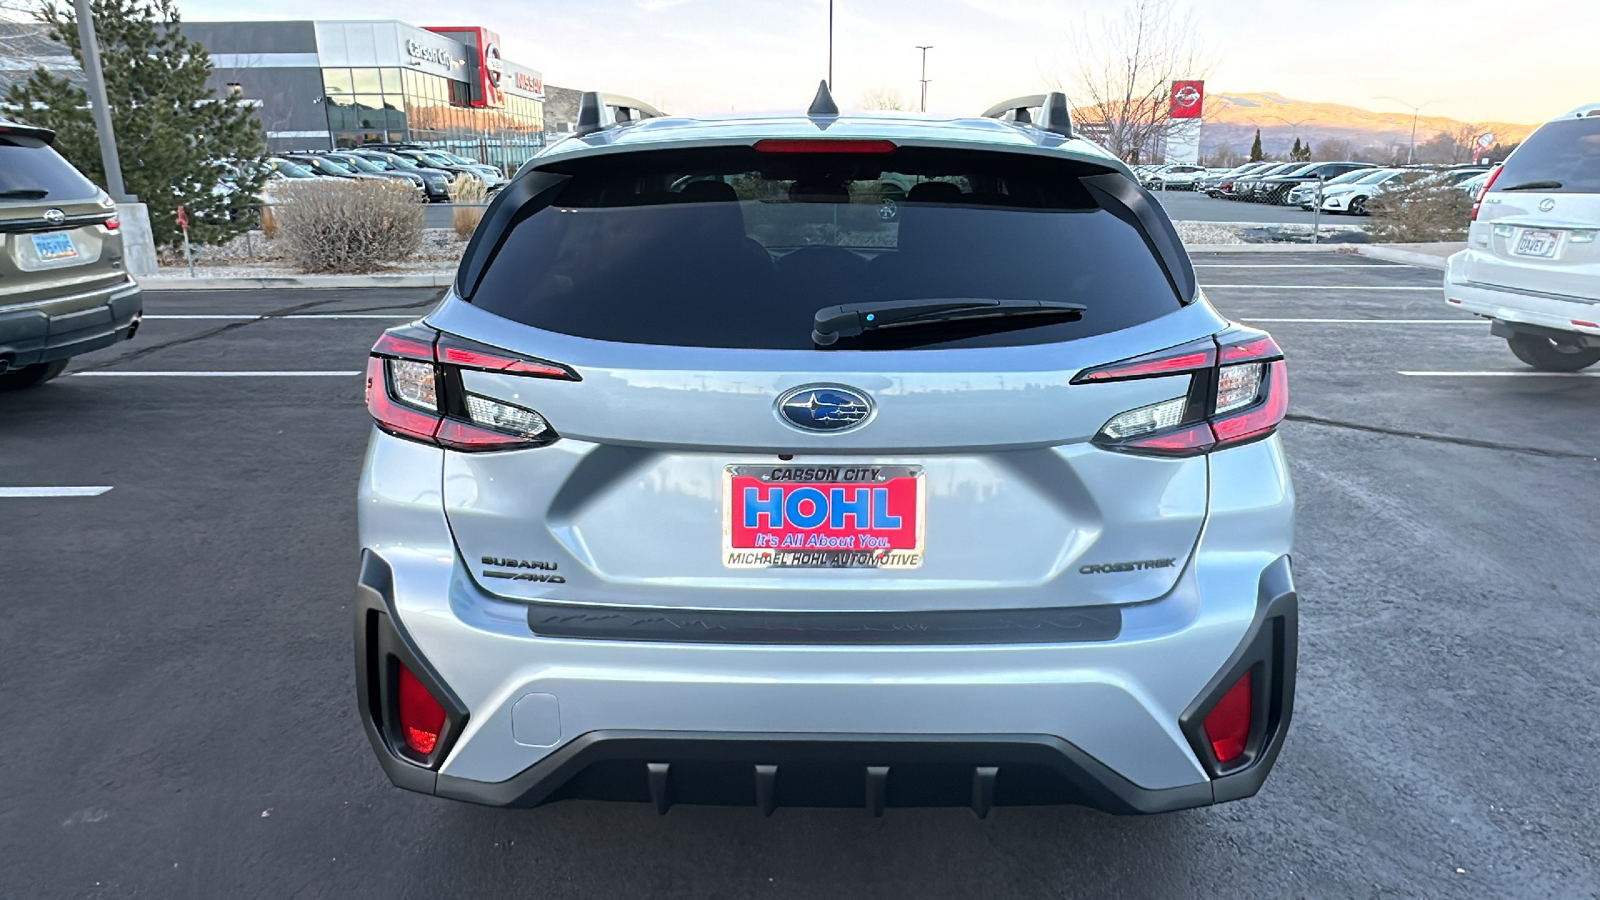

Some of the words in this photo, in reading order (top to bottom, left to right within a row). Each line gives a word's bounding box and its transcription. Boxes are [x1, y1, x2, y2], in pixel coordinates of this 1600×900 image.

[407, 38, 438, 63] Carson
[438, 47, 453, 71] City
[515, 72, 542, 94] NISSAN
[1519, 238, 1546, 253] DAVEY
[771, 468, 839, 481] CARSON
[843, 468, 881, 481] CITY
[743, 487, 902, 529] HOHL
[755, 533, 779, 547] It's
[781, 534, 804, 547] All
[805, 534, 854, 547] About
[858, 534, 890, 547] You.
[481, 556, 558, 571] SUBARU
[728, 552, 787, 565] MICHAEL
[791, 552, 828, 566] HOHL
[832, 552, 919, 566] AUTOMOTIVE
[1078, 557, 1176, 574] CROSSTREK
[512, 573, 566, 584] AWD
